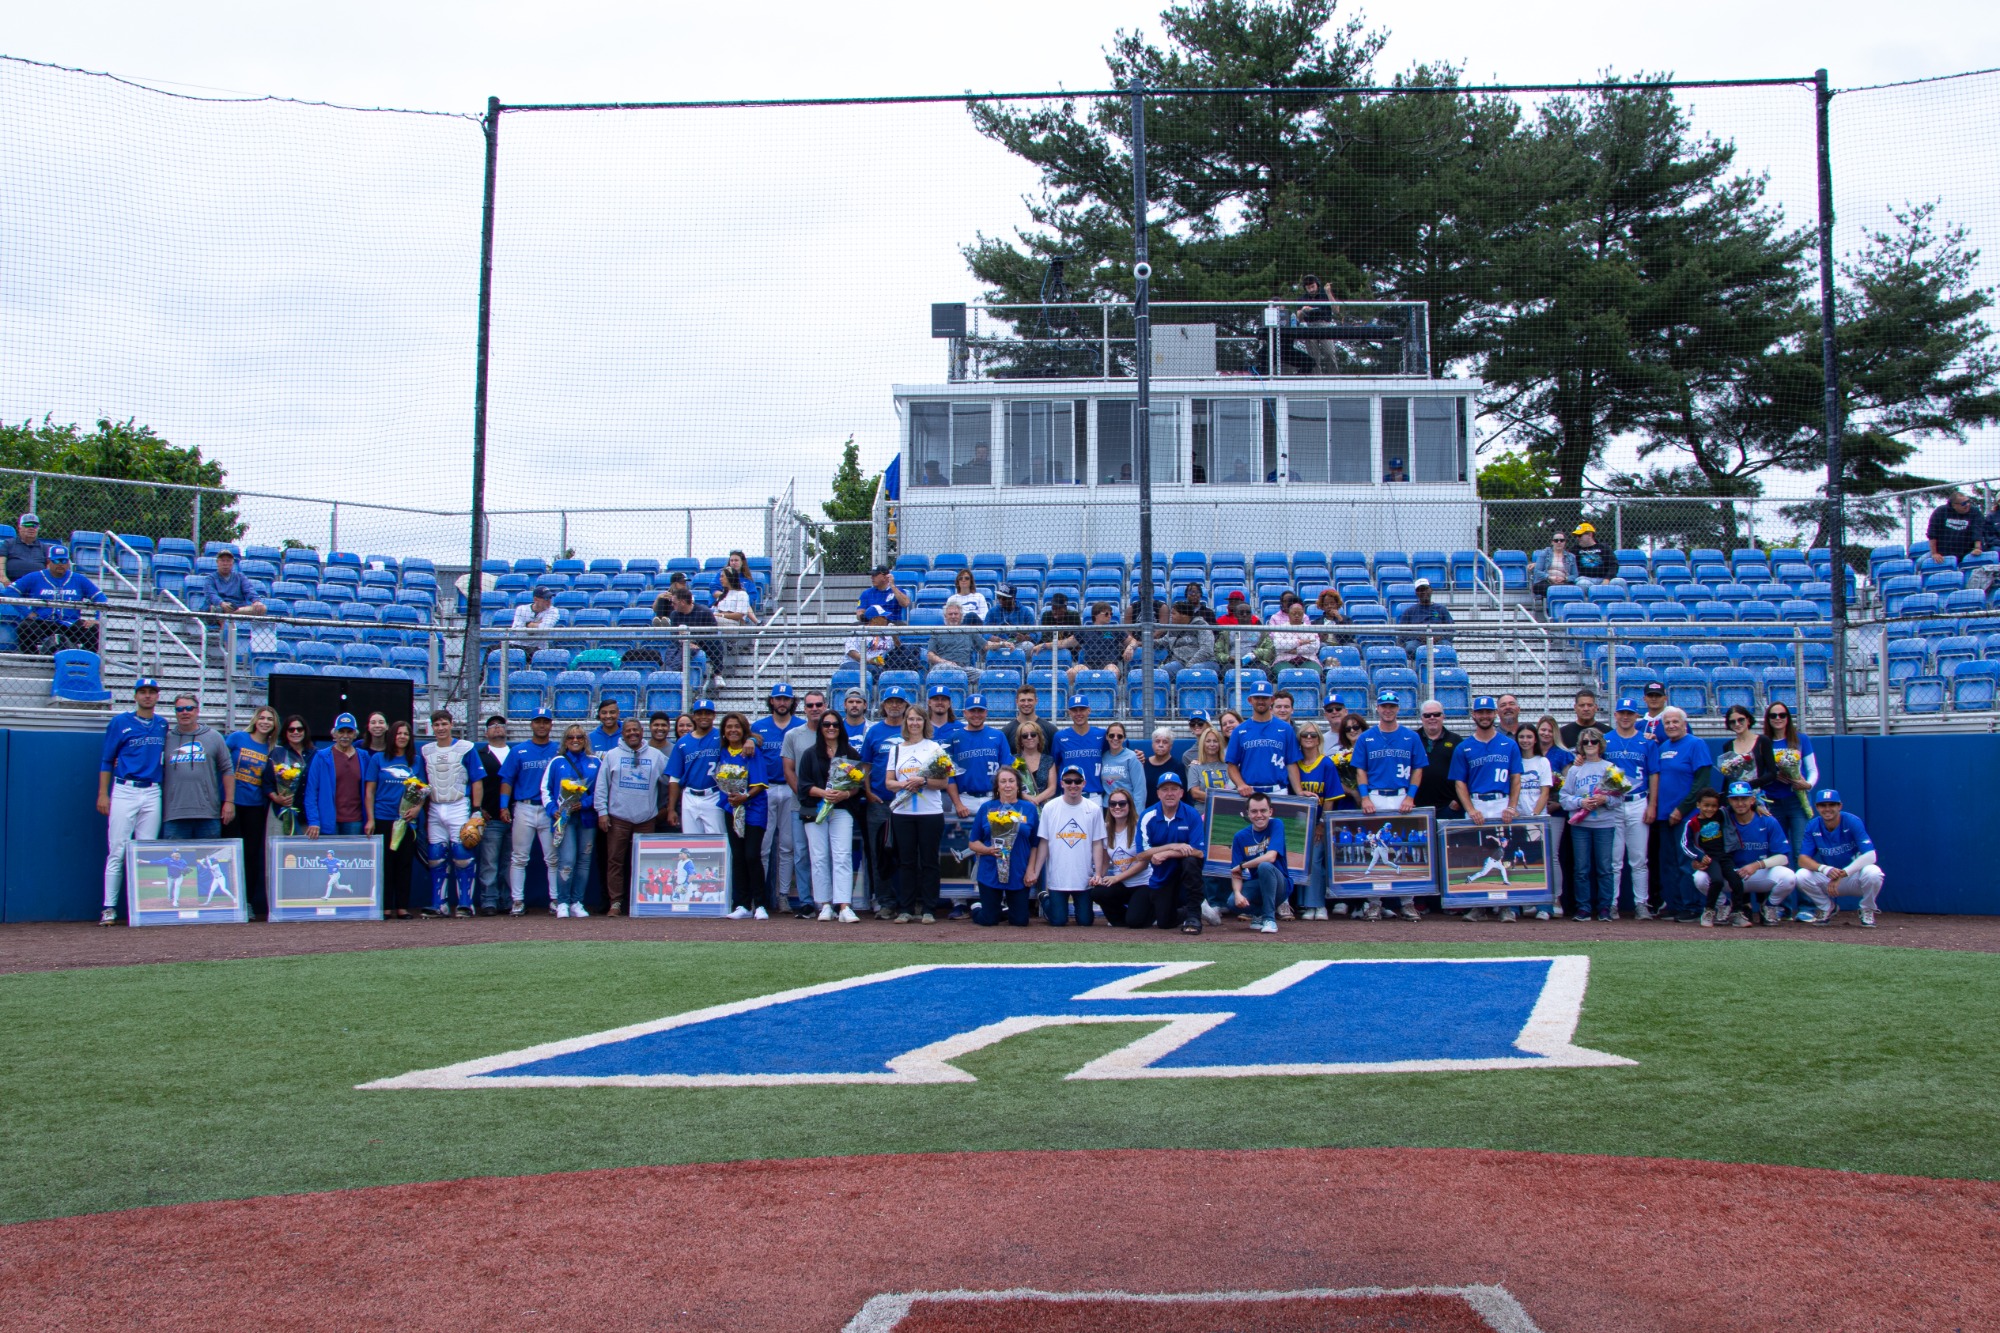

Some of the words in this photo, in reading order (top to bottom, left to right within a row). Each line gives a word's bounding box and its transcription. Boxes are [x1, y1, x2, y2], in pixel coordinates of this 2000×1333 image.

[1242, 738, 1284, 750] HOFSTRA
[957, 748, 998, 761] HOFSTRA
[1065, 748, 1102, 759] HOFSTR
[1270, 752, 1286, 770] 44
[1368, 748, 1411, 760] HOFSTRA
[1468, 754, 1509, 769] HOFSTRA
[1395, 763, 1411, 780] 34
[1494, 768, 1509, 783] 10
[1635, 765, 1644, 780] 5
[355, 953, 1637, 1090] H
